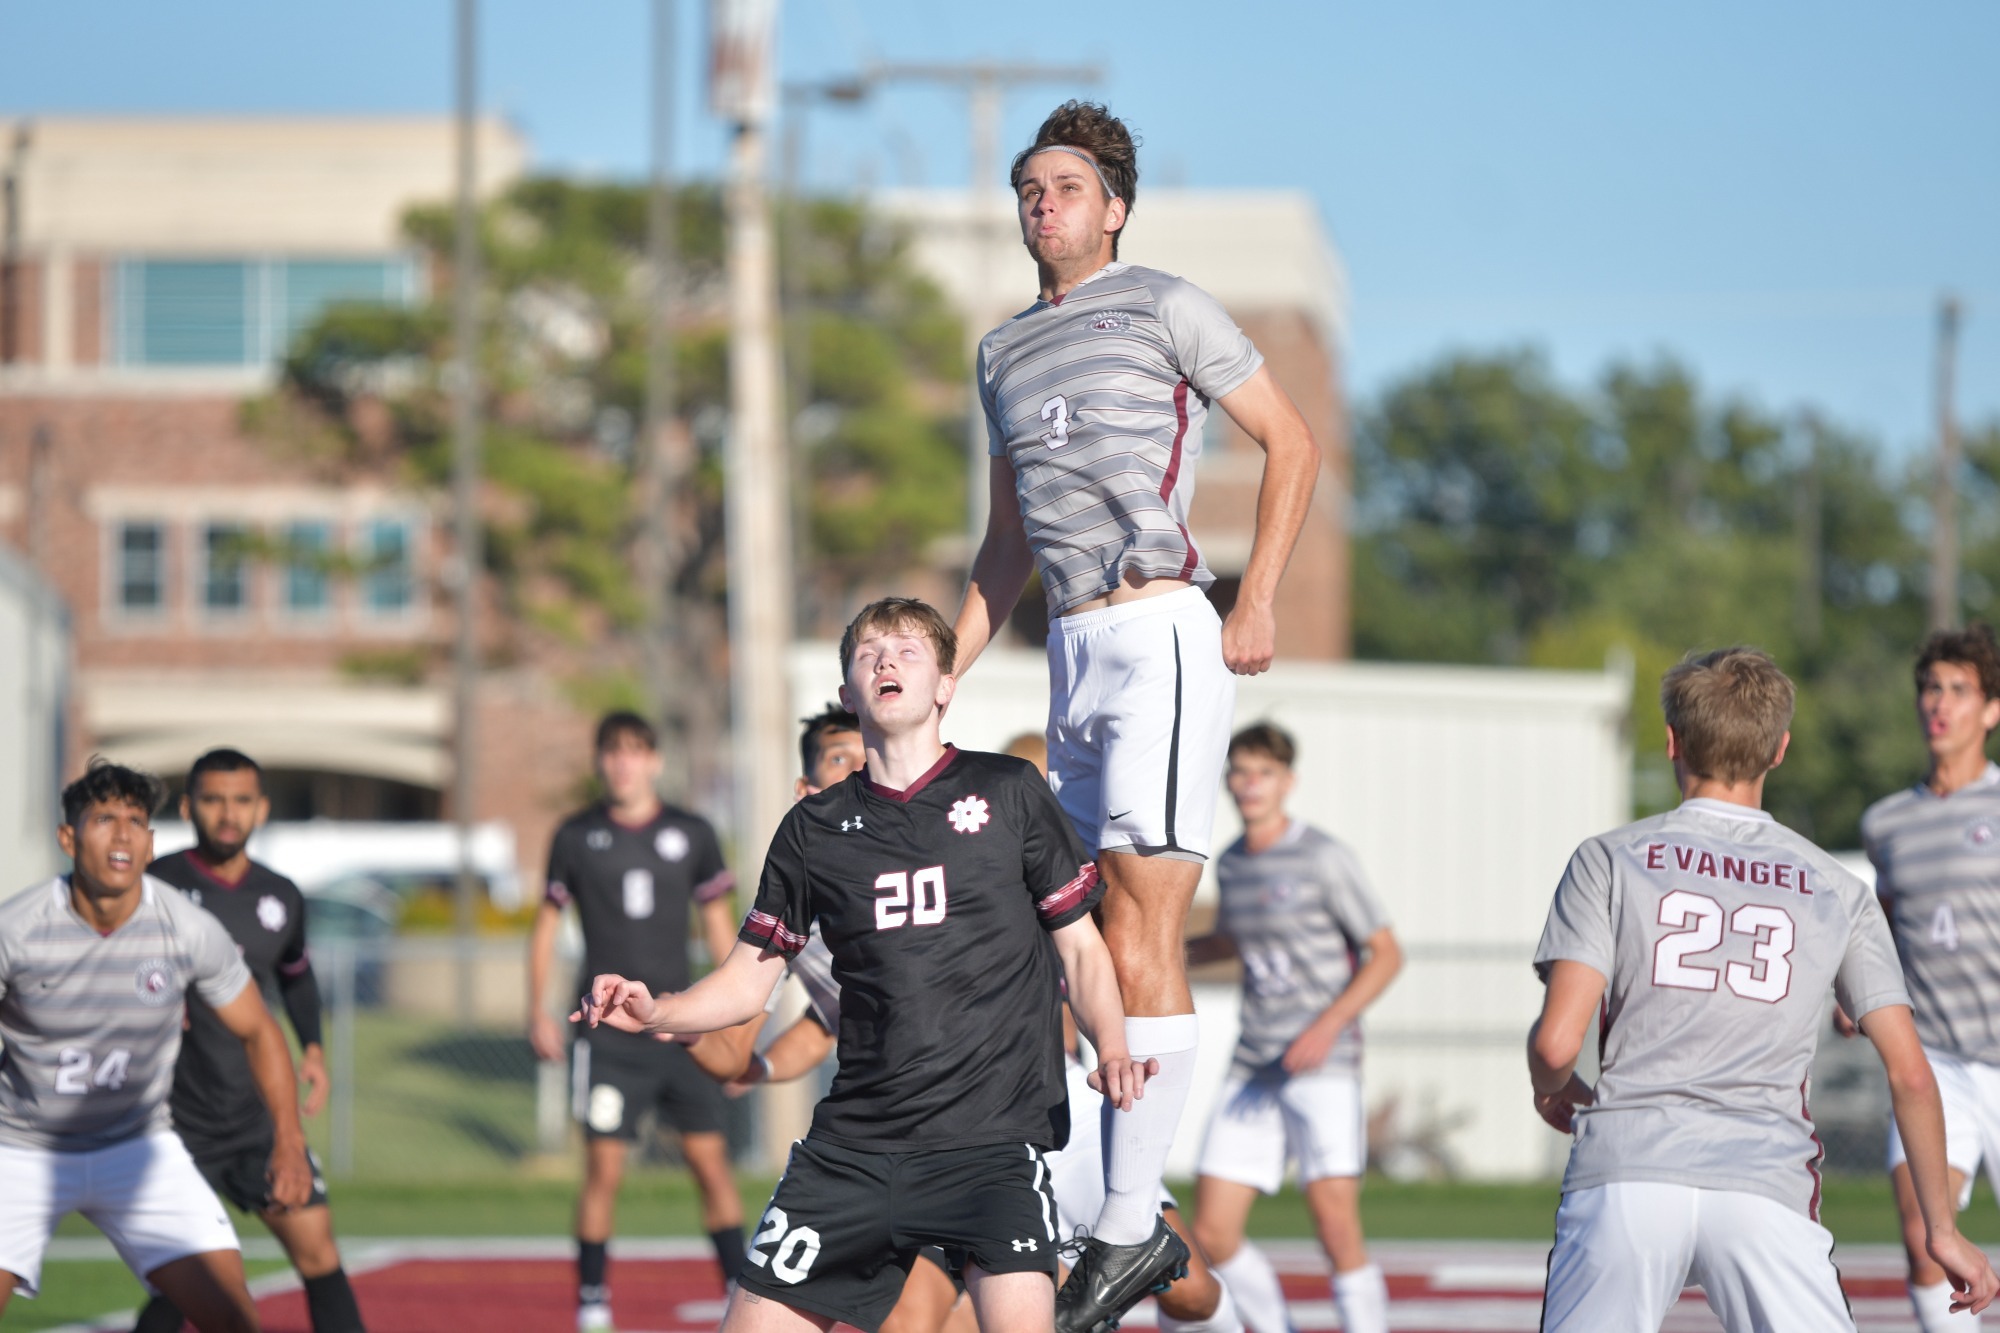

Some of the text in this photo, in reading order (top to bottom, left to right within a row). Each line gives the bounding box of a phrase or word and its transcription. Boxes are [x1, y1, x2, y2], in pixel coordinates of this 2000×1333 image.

[1040, 394, 1070, 451] 3
[874, 864, 947, 931] 20
[1646, 843, 1814, 896] EVANGEL
[1652, 889, 1796, 1004] 23
[1930, 902, 1959, 951] 4
[55, 1047, 131, 1094] 24
[747, 1206, 821, 1284] 20
